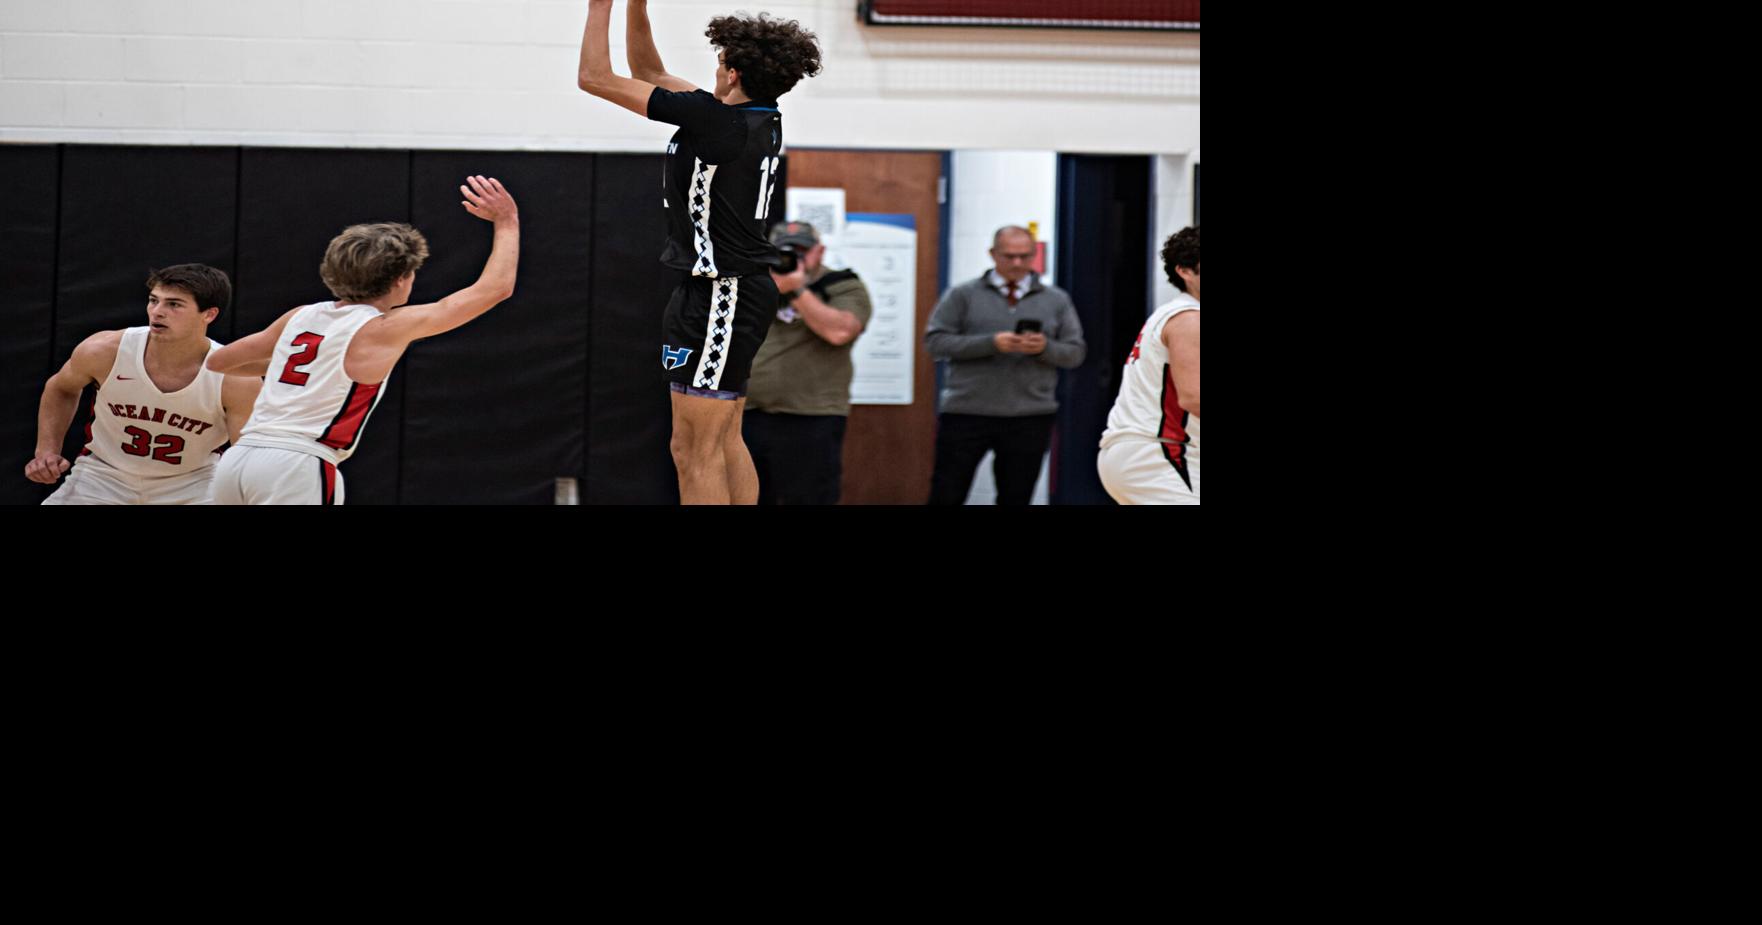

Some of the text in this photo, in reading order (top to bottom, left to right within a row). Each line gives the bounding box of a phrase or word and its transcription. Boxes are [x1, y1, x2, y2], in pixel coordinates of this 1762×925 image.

[278, 331, 325, 386] 2
[121, 424, 186, 466] 32
[167, 412, 213, 436] CITY
